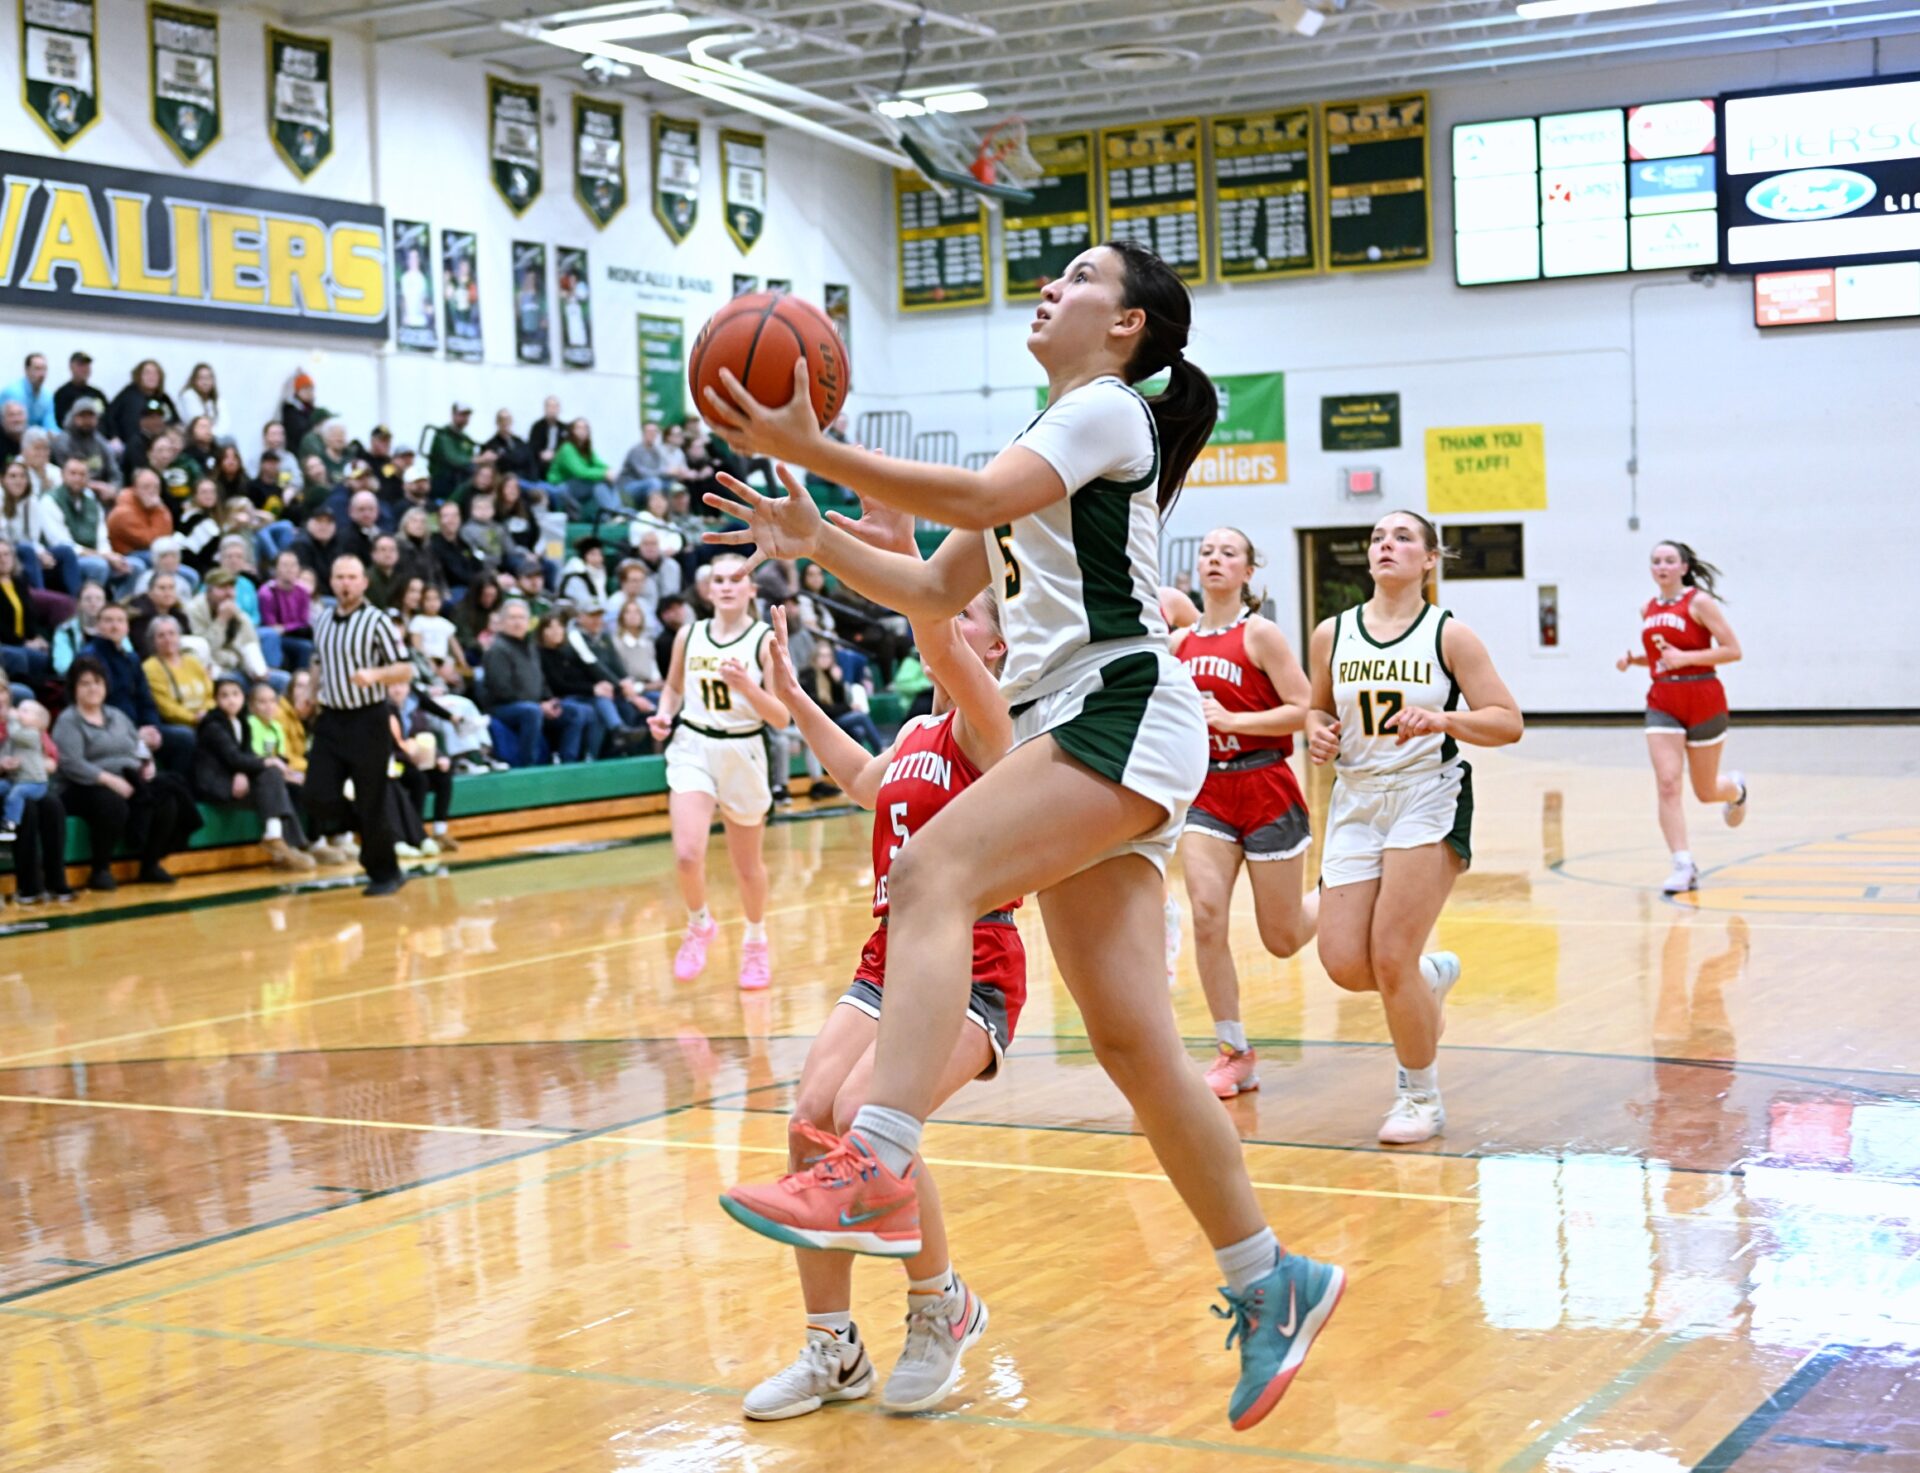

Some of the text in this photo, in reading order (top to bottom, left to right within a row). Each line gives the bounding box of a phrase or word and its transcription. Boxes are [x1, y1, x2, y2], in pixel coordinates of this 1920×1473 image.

[1439, 432, 1522, 453] THANK YOU
[1455, 454, 1509, 475] STAFF!
[1339, 659, 1431, 685] RONCALLI
[700, 678, 732, 711] 10
[1358, 689, 1404, 738] 12
[889, 802, 910, 861] 5
